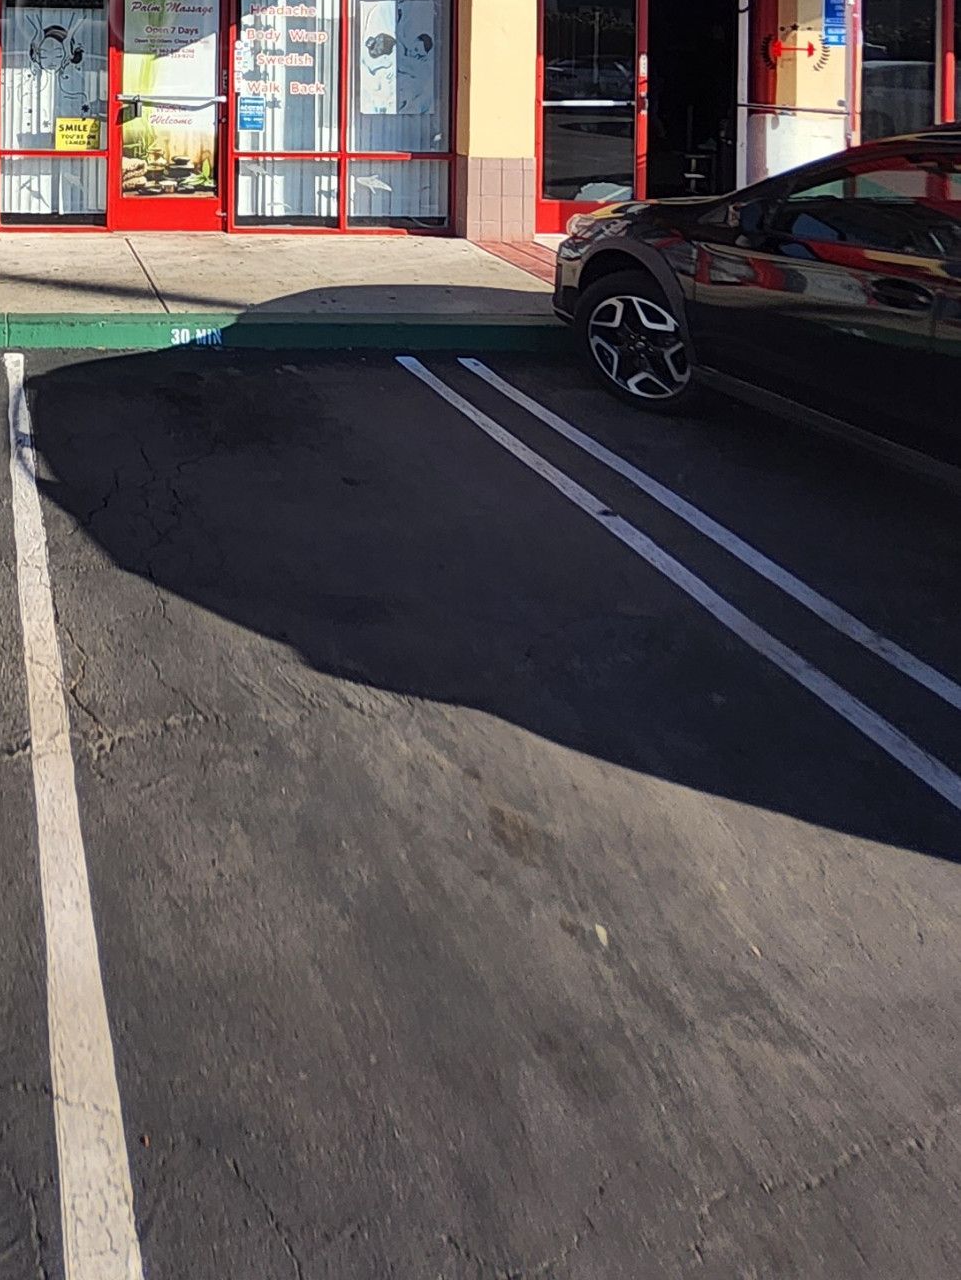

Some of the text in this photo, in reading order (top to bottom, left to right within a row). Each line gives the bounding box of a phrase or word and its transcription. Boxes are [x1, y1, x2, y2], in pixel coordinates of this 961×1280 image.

[131, 1, 214, 16] Palm Massage
[250, 4, 317, 16] Headache
[145, 26, 198, 36] Open 7 Days
[247, 29, 328, 43] Body Wrap
[256, 53, 313, 66] Swedish
[248, 80, 324, 94] Walk Back
[150, 114, 192, 125] Welcome
[171, 328, 222, 345] 30 MIN
